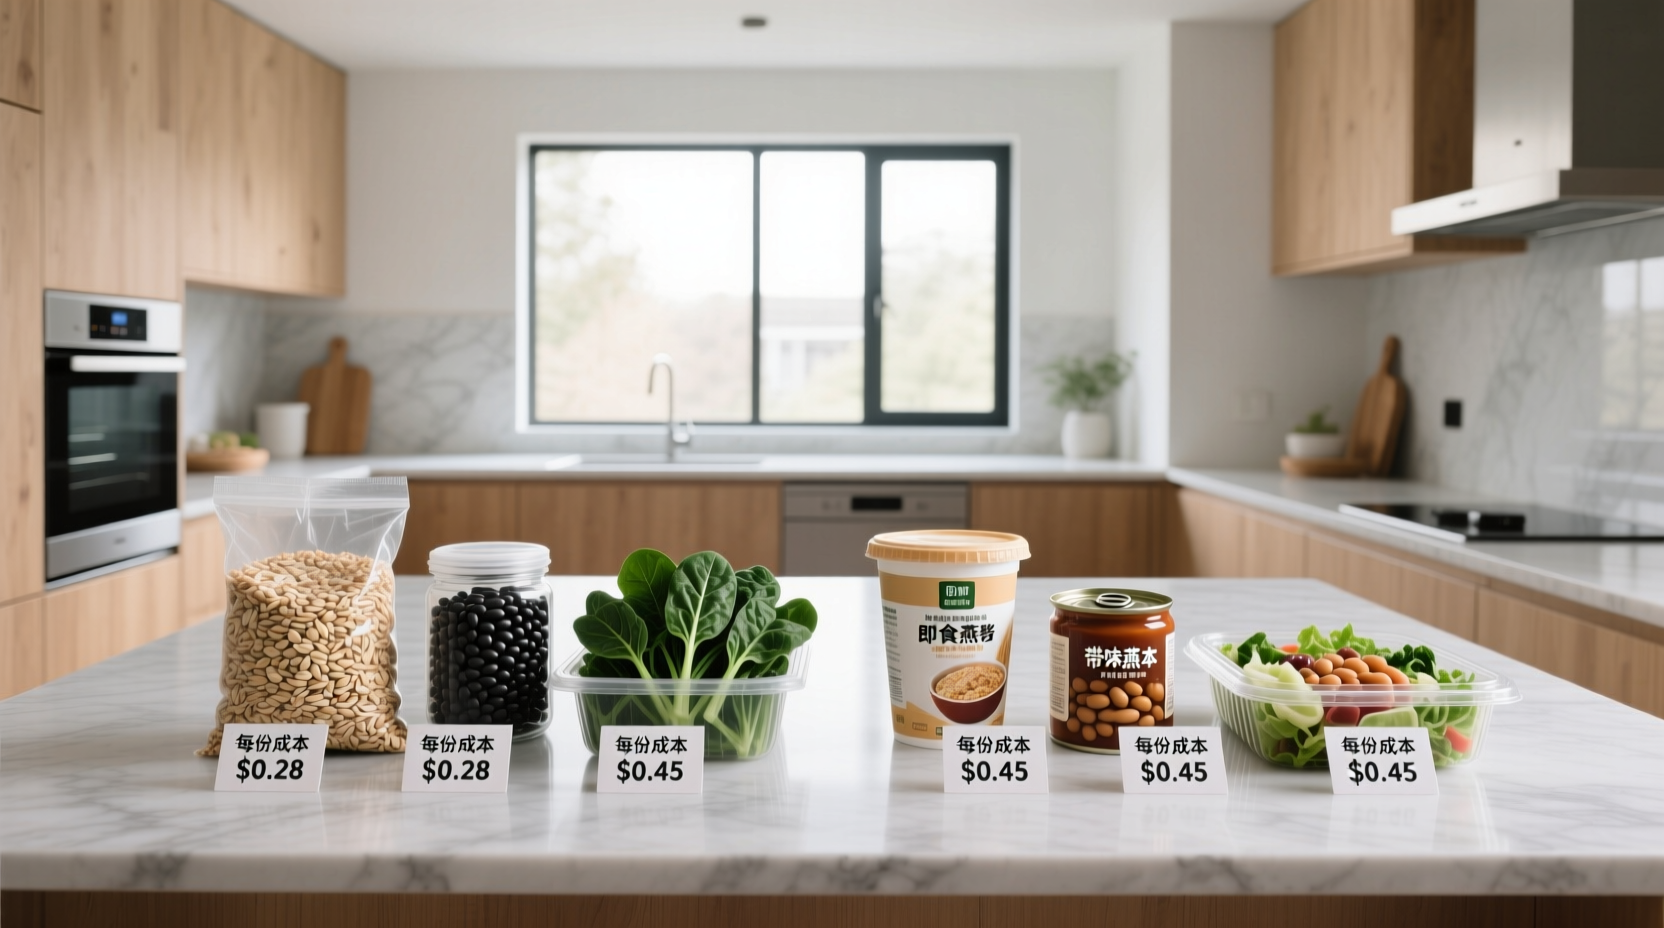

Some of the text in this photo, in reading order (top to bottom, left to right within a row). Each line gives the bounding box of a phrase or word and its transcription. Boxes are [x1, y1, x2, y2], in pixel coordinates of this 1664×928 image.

[236, 734, 310, 753] 每份成本
[421, 734, 495, 754] 每份成本
[615, 735, 688, 755] 每份成本
[957, 735, 1031, 755] 每份成本
[1135, 736, 1208, 755] 每份成本
[1341, 736, 1416, 755] 每份成本
[235, 756, 304, 784] $0.28
[422, 757, 490, 784] $0.28
[616, 758, 684, 785] $0.45
[961, 759, 1029, 785] $0.45
[1141, 759, 1208, 786] $0.45
[1348, 759, 1417, 787] $0.45
